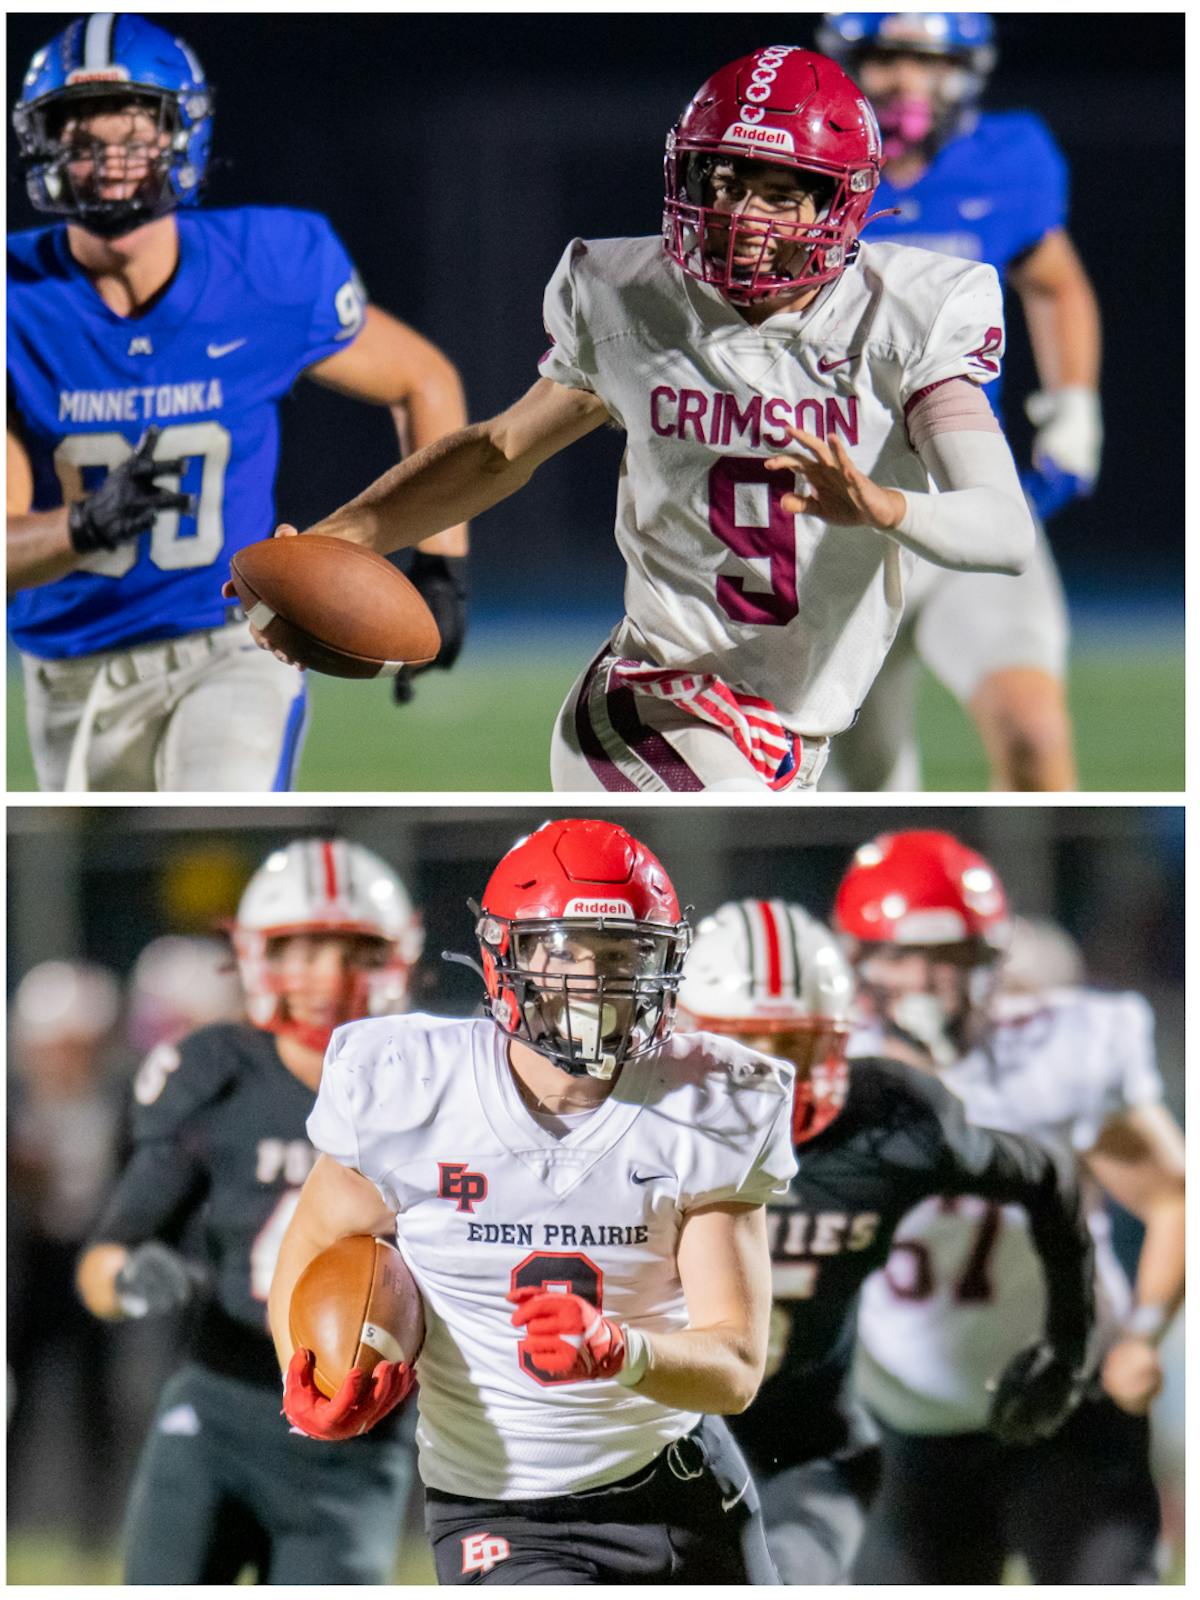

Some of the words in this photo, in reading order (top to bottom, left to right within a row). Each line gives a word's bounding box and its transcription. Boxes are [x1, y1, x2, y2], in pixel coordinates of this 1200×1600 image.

[732, 125, 787, 144] Riddell
[58, 378, 223, 423] MINNETONKA
[650, 385, 860, 448] CRIMSON
[708, 456, 800, 627] 9
[573, 902, 627, 914] Riddell
[437, 1162, 489, 1214] EP
[466, 1222, 533, 1246] EDEN
[543, 1223, 649, 1247] PRAIRIE
